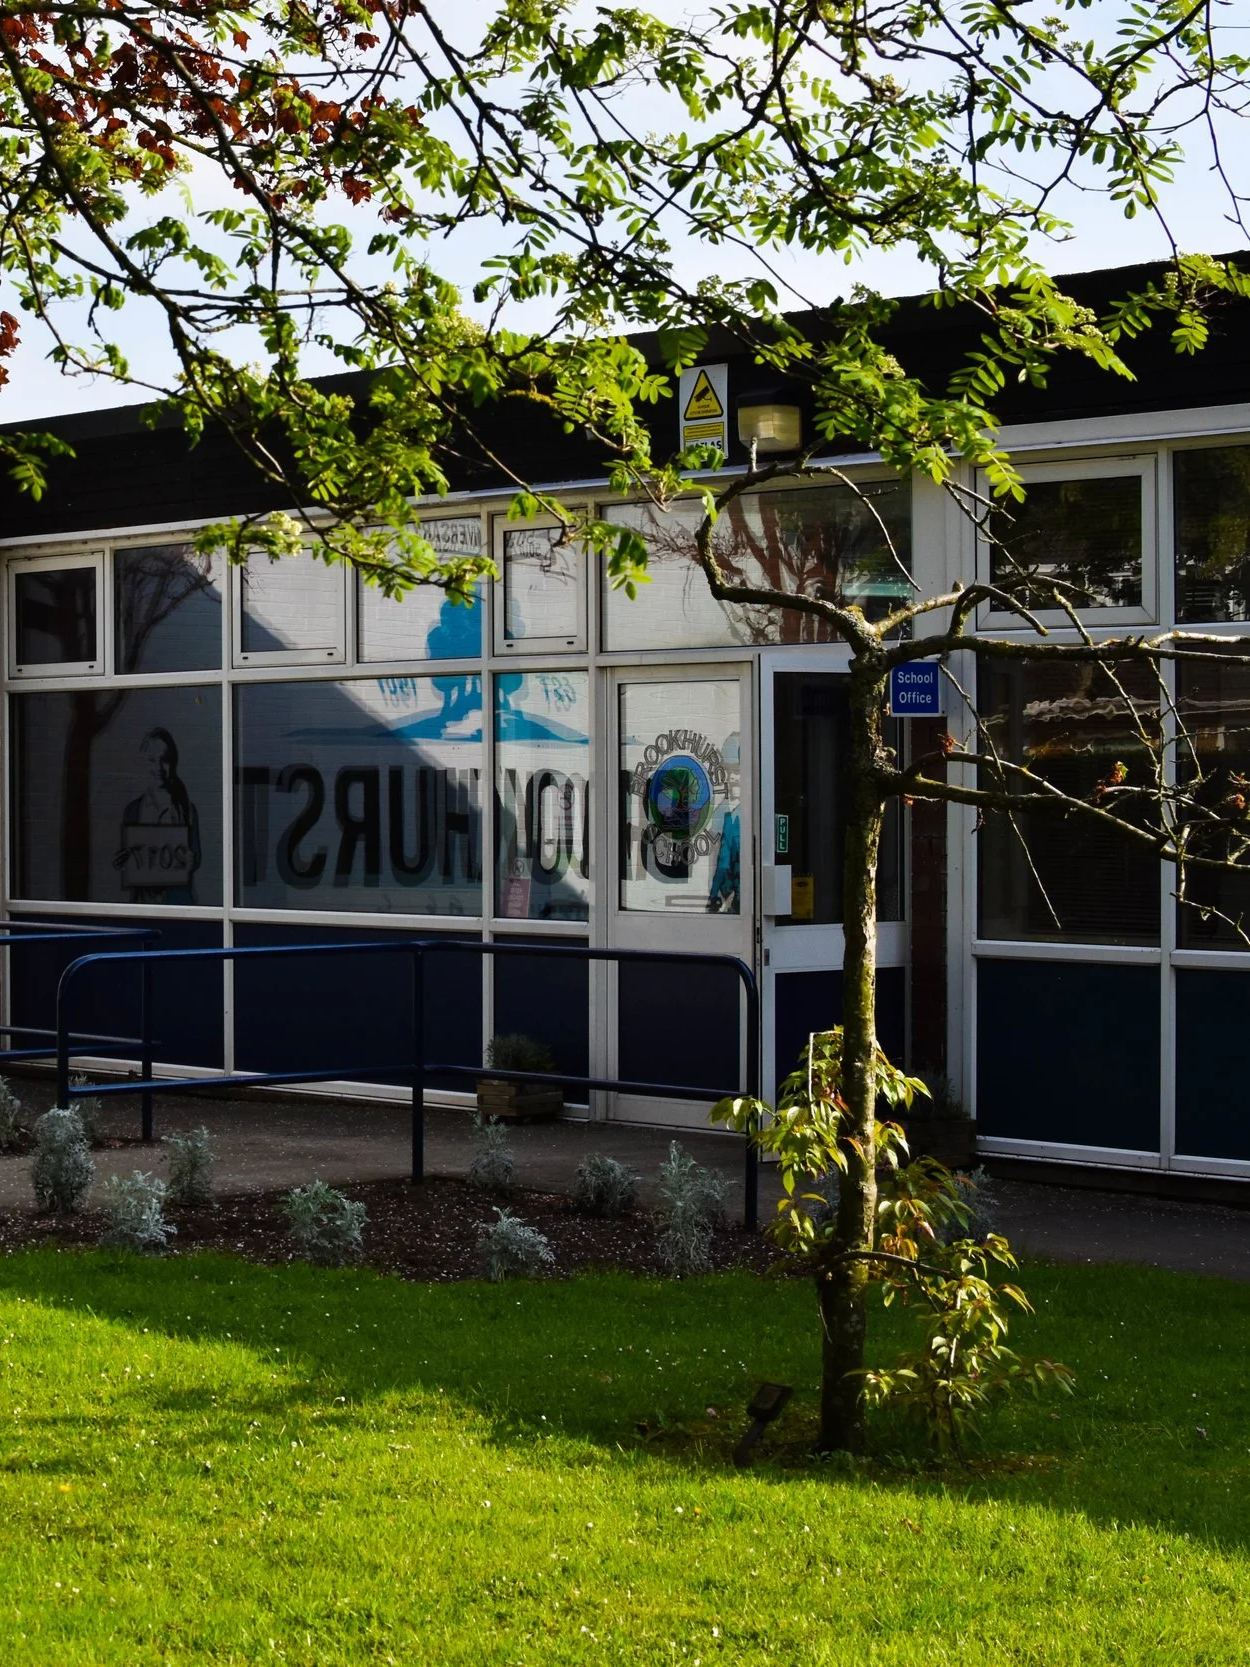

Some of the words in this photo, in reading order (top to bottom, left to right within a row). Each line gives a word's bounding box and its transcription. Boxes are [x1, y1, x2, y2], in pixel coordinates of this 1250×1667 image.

[897, 671, 933, 683] School
[899, 691, 932, 703] Office
[630, 729, 729, 800] BROOKHURST
